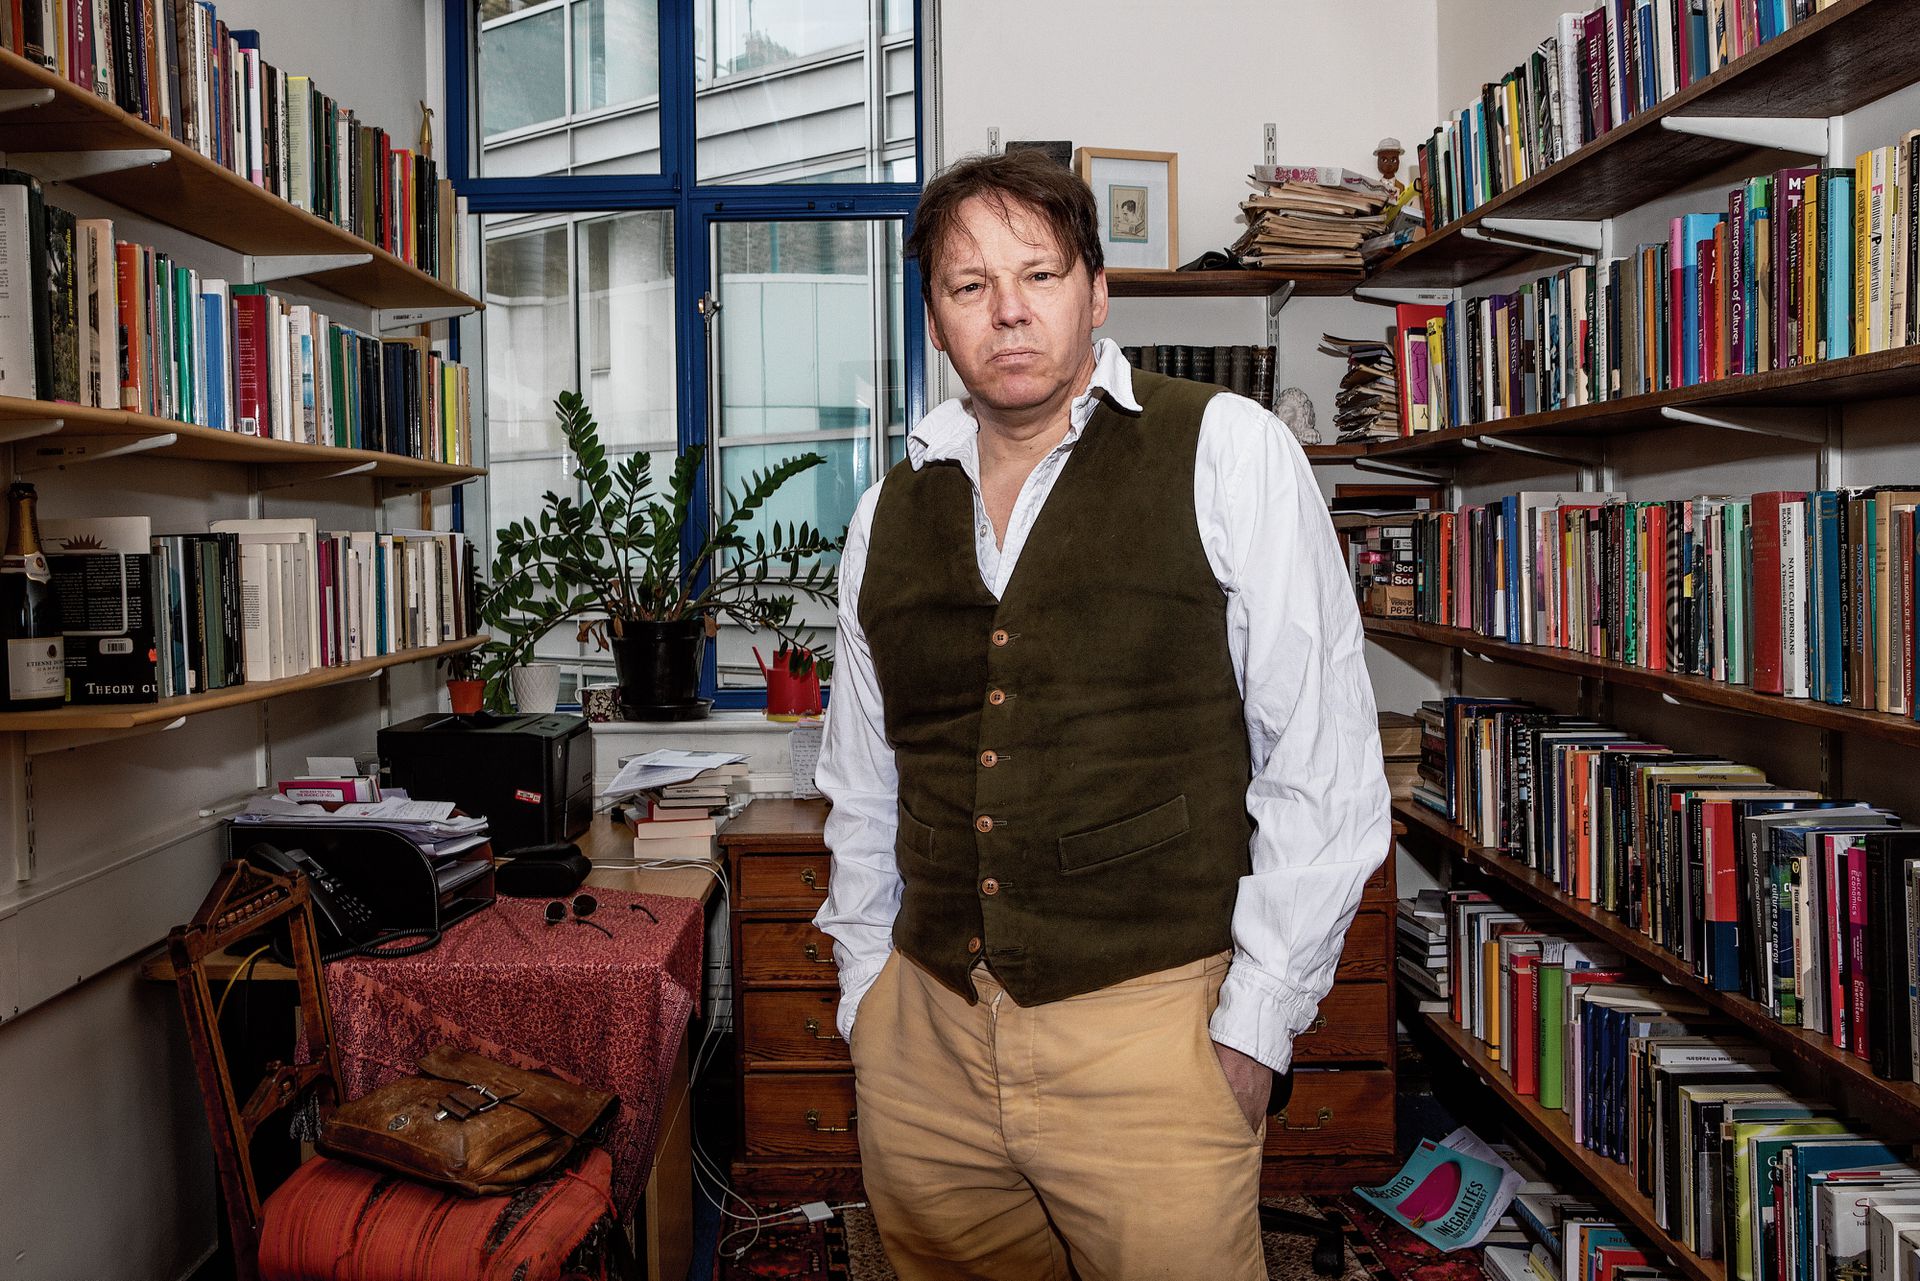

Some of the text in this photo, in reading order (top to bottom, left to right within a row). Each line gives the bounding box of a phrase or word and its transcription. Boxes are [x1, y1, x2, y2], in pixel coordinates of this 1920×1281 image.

[1607, 18, 1616, 88] INEQUALITY
[1622, 20, 1630, 76] ORIENTALISM
[1589, 35, 1600, 109] THE PYRATES
[1820, 174, 1828, 209] Feminism
[1857, 190, 1865, 215] GENDER
[1790, 232, 1798, 267] Myths
[1819, 226, 1827, 272] Anthropology
[1731, 193, 1742, 346] The Interpretation of Cultures
[1510, 316, 1517, 335] ON
[1394, 575, 1414, 585] Sco
[1395, 563, 1413, 573] Sco
[1751, 832, 1759, 867] dictionary
[1771, 883, 1779, 919] cultures
[1771, 933, 1780, 964] energy
[1434, 1180, 1483, 1237] INÉGALITÉS
